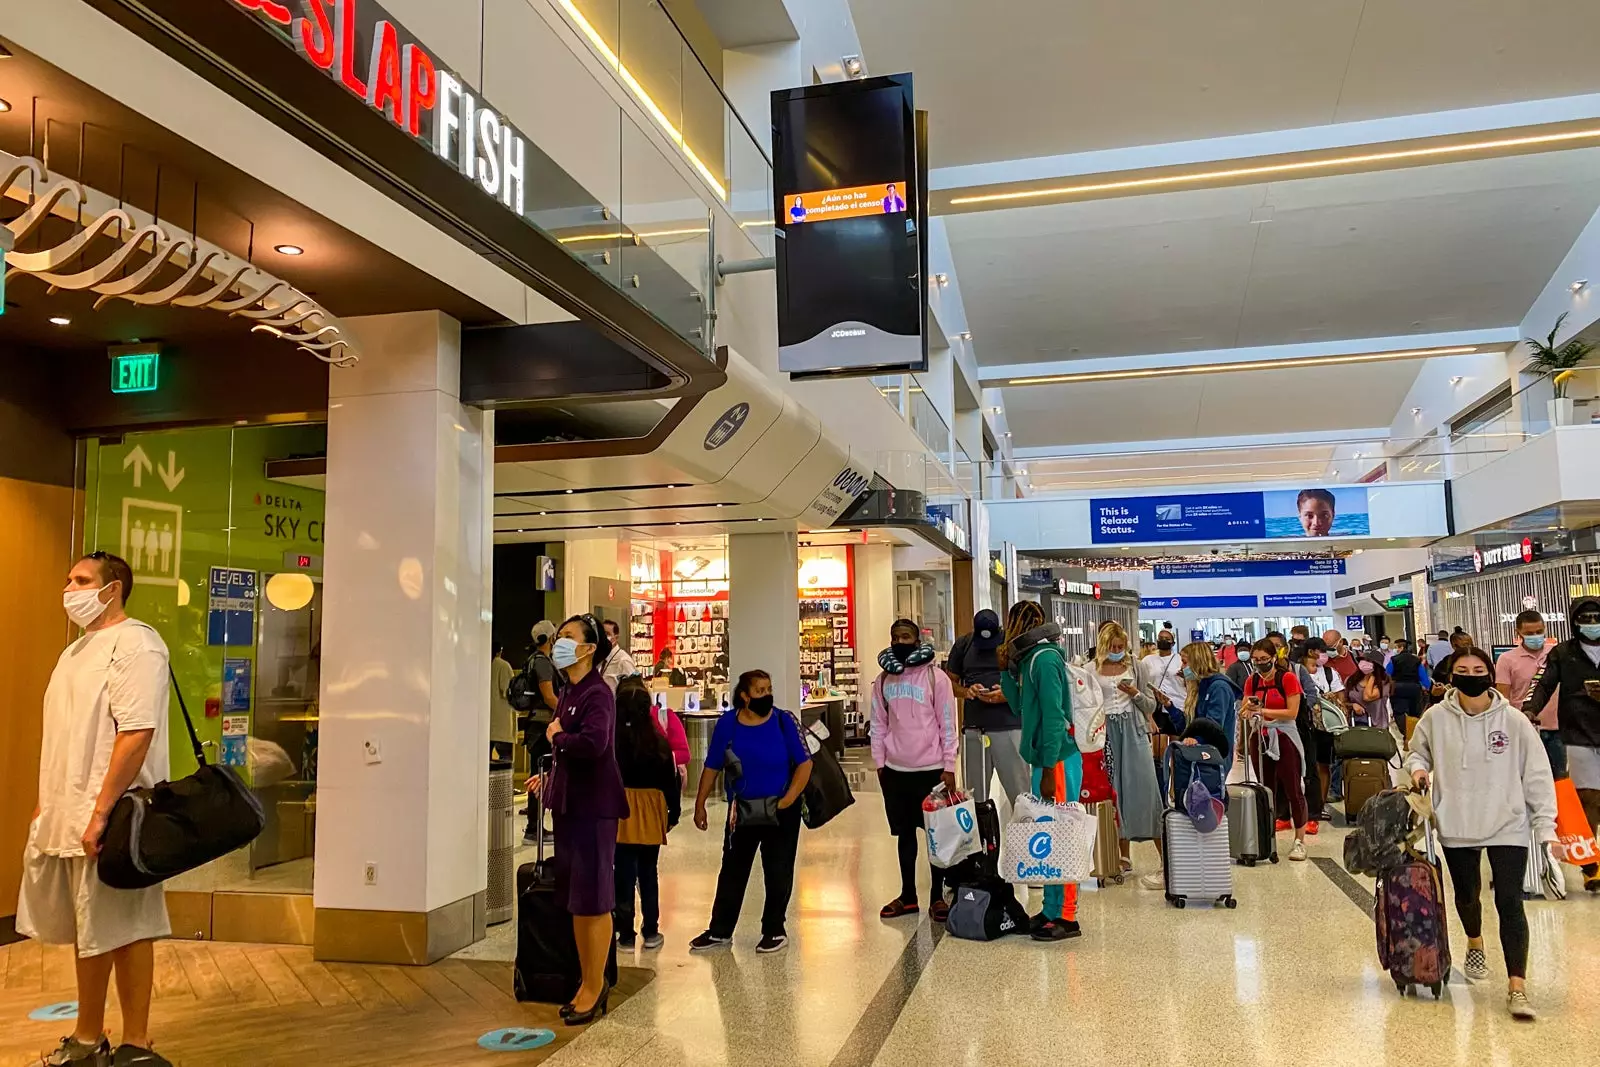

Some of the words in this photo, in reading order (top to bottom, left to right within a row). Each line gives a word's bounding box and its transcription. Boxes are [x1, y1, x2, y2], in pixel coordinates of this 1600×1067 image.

[821, 195, 841, 205] ¿Aún
[853, 191, 867, 199] has
[806, 204, 849, 214] completado
[850, 201, 857, 209] el
[831, 329, 866, 338] JCDecaux
[119, 358, 152, 389] EXIT
[266, 494, 302, 511] DELTA
[1100, 506, 1120, 516] This
[1121, 506, 1129, 515] is
[264, 513, 300, 540] SKY
[1100, 515, 1139, 526] Relaxed
[1100, 525, 1135, 535] Status.
[1484, 548, 1502, 566] DUTY
[1502, 543, 1522, 561] FREE
[213, 571, 245, 586] LEVEL
[247, 574, 253, 586] 3
[1348, 620, 1361, 628] 22
[1016, 861, 1062, 879] Cookies
